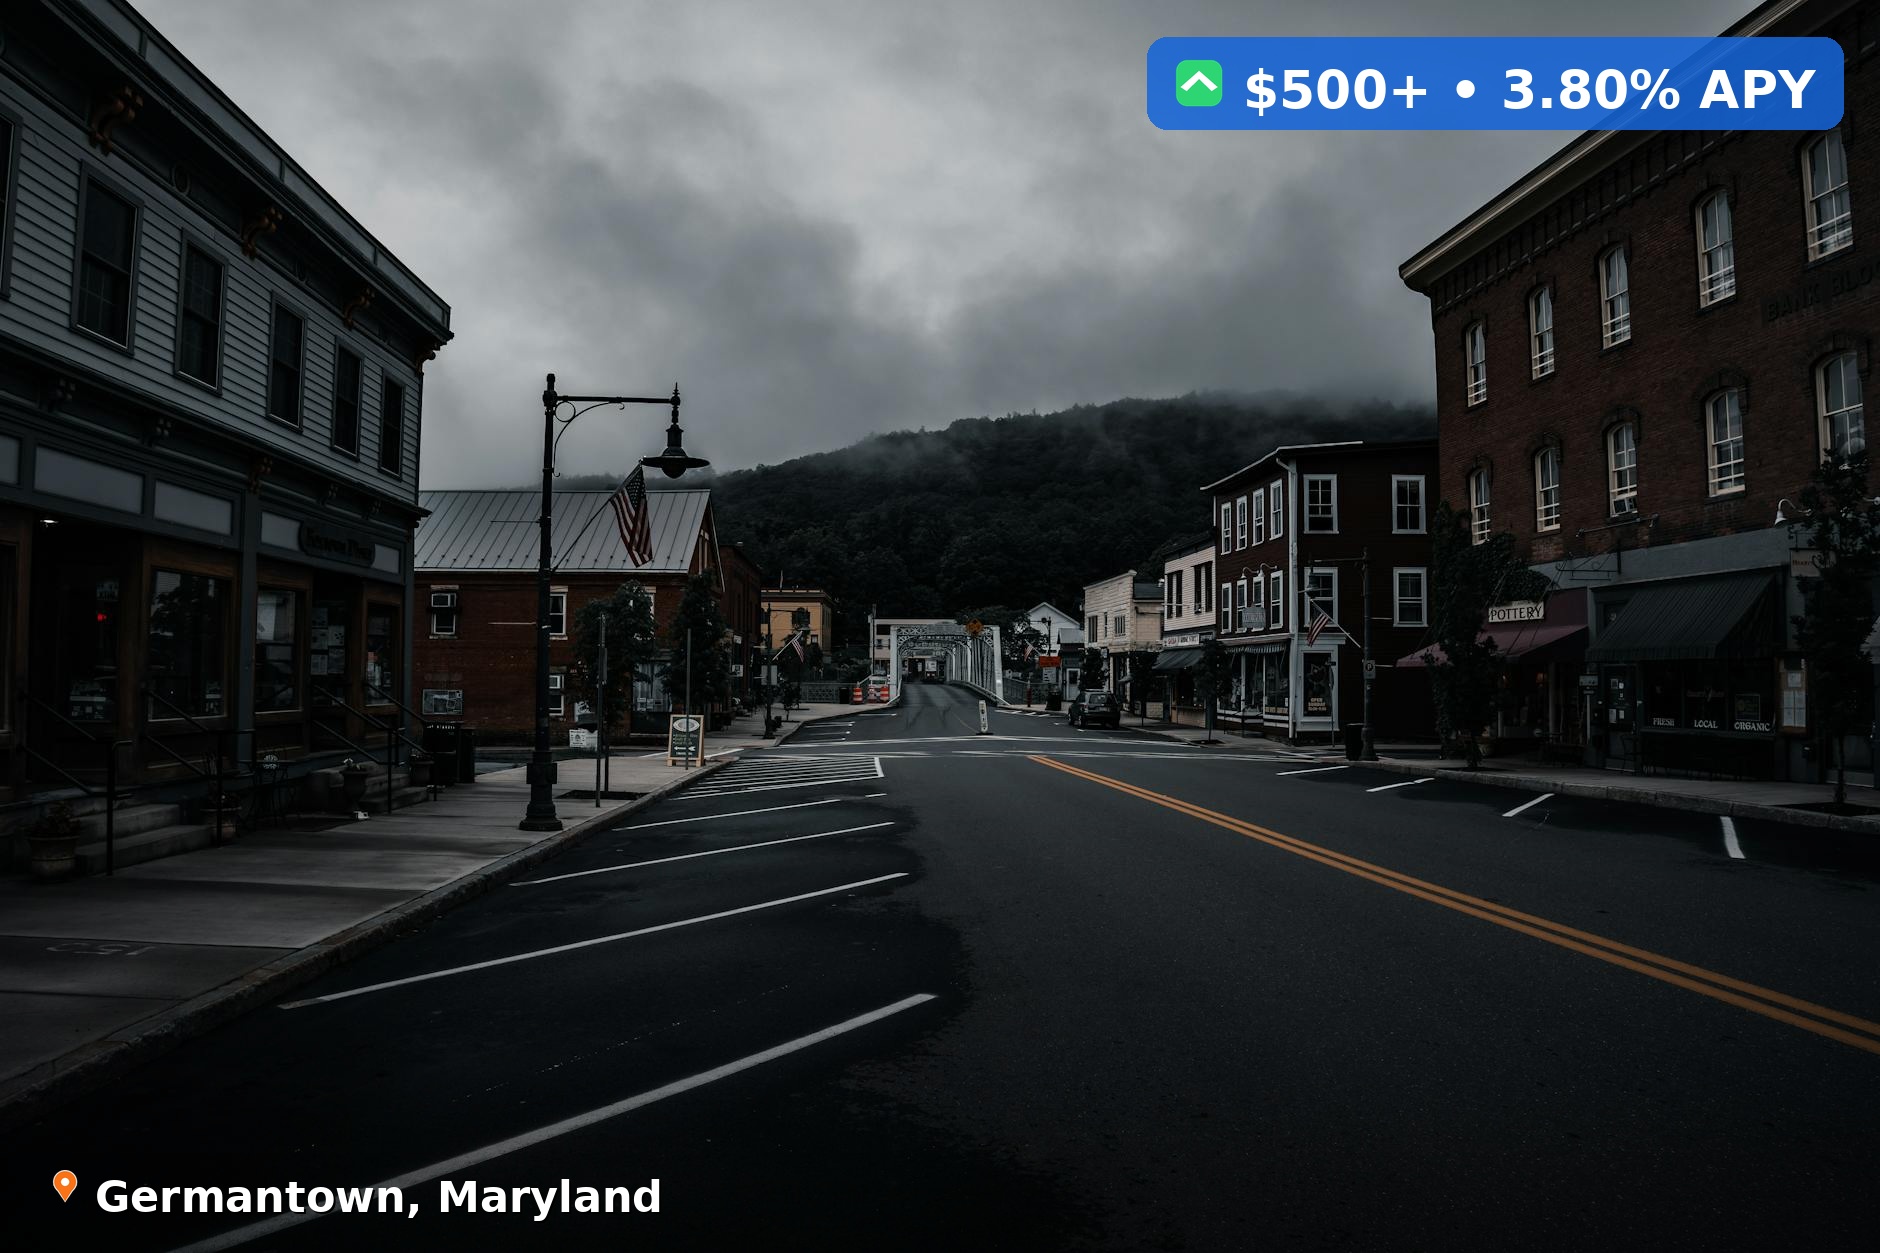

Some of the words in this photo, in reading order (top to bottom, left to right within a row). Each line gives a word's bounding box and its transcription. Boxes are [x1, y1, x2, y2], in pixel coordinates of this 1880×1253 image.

[1490, 605, 1543, 621] POTTERY
[1652, 717, 1675, 727] FRESH
[1693, 718, 1719, 730] LOCAL
[1733, 720, 1771, 732] ORGANIC
